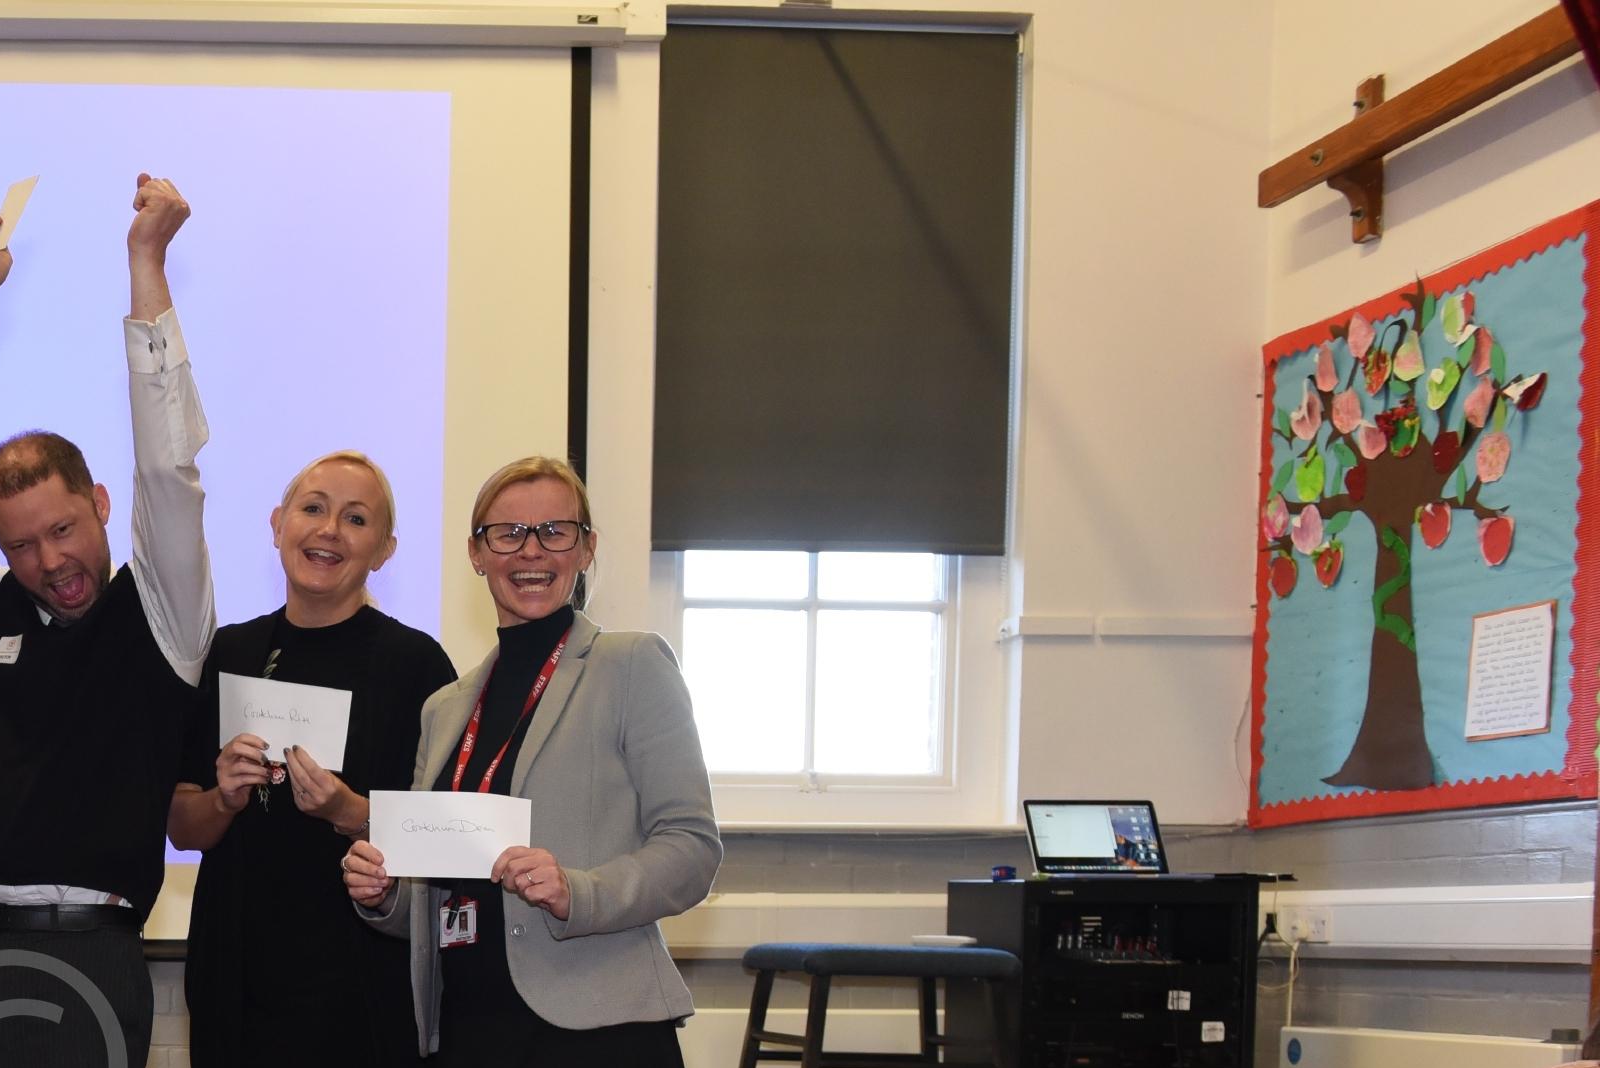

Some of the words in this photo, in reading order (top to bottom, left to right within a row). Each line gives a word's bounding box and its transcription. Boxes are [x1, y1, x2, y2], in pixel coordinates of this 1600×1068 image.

[549, 643, 567, 665] STAFF
[532, 675, 547, 698] STAFF
[462, 733, 474, 753] STAFF
